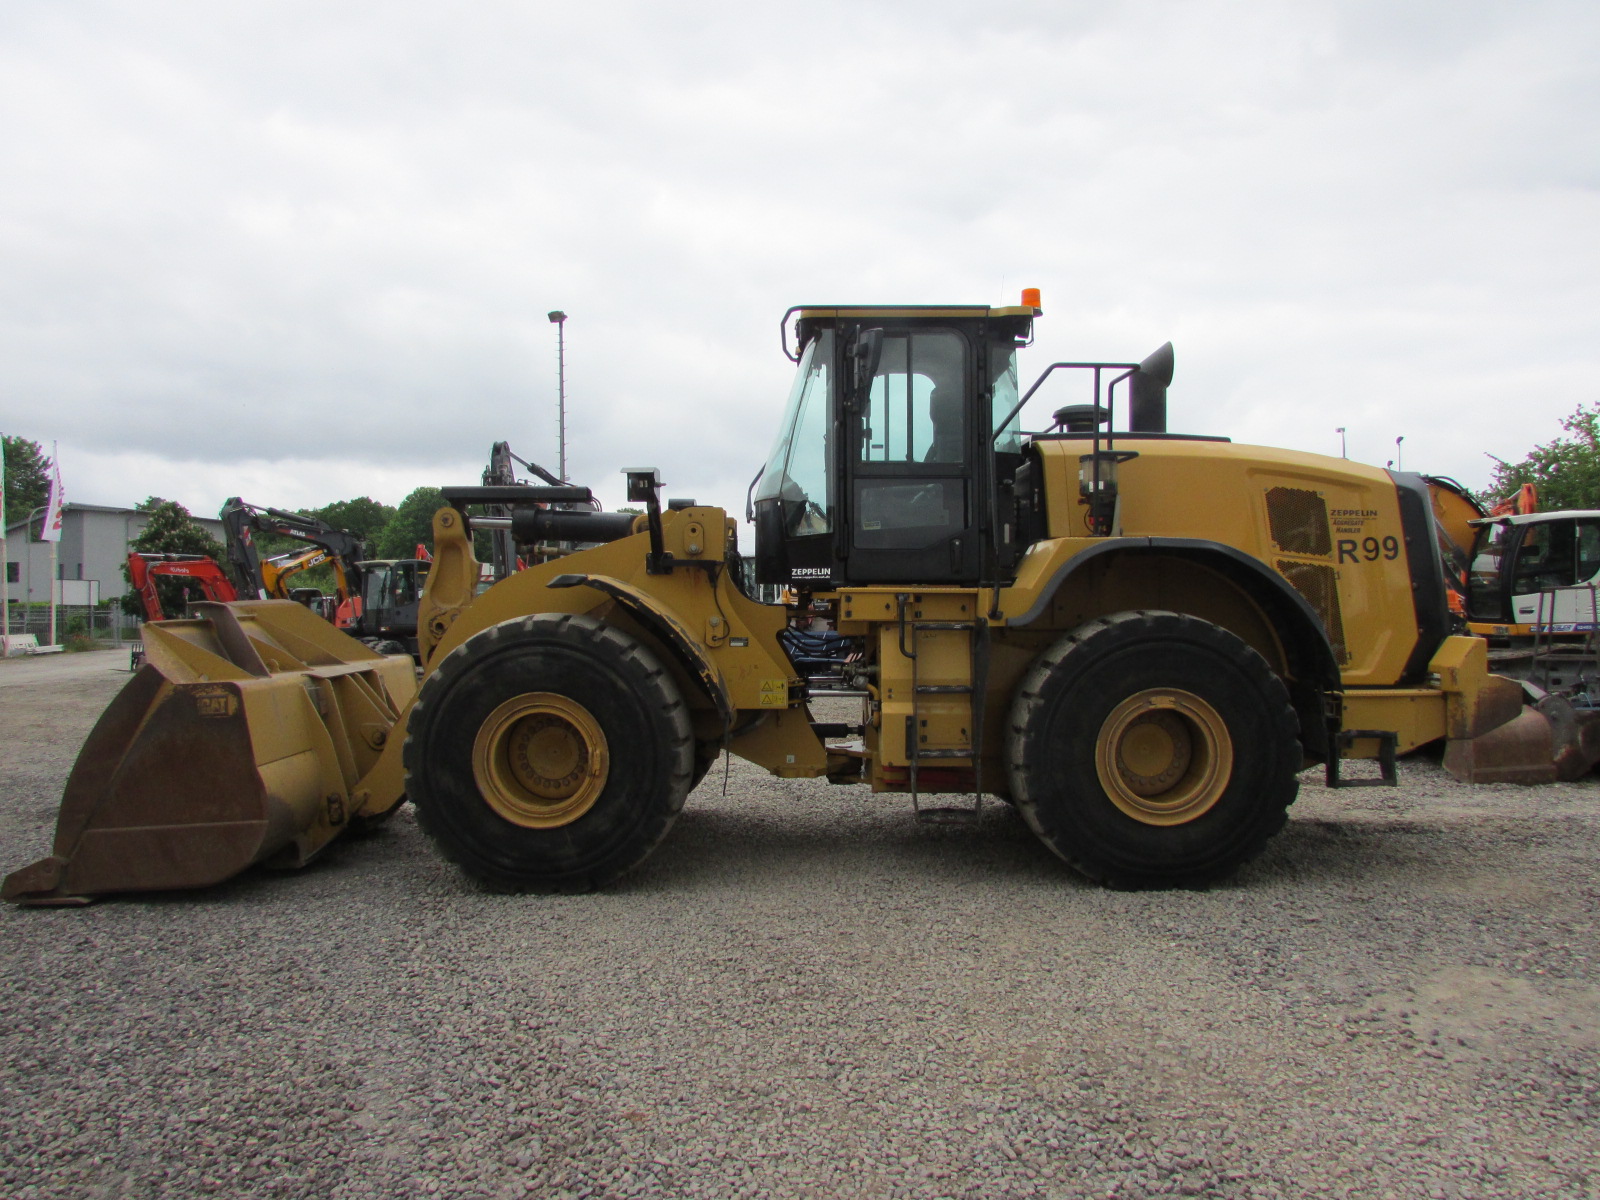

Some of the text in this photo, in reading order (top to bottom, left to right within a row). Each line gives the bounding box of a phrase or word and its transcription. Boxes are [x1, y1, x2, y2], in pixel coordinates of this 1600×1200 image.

[1330, 509, 1378, 517] ZEPPELIN
[1337, 535, 1399, 565] R99
[308, 553, 326, 567] JCB
